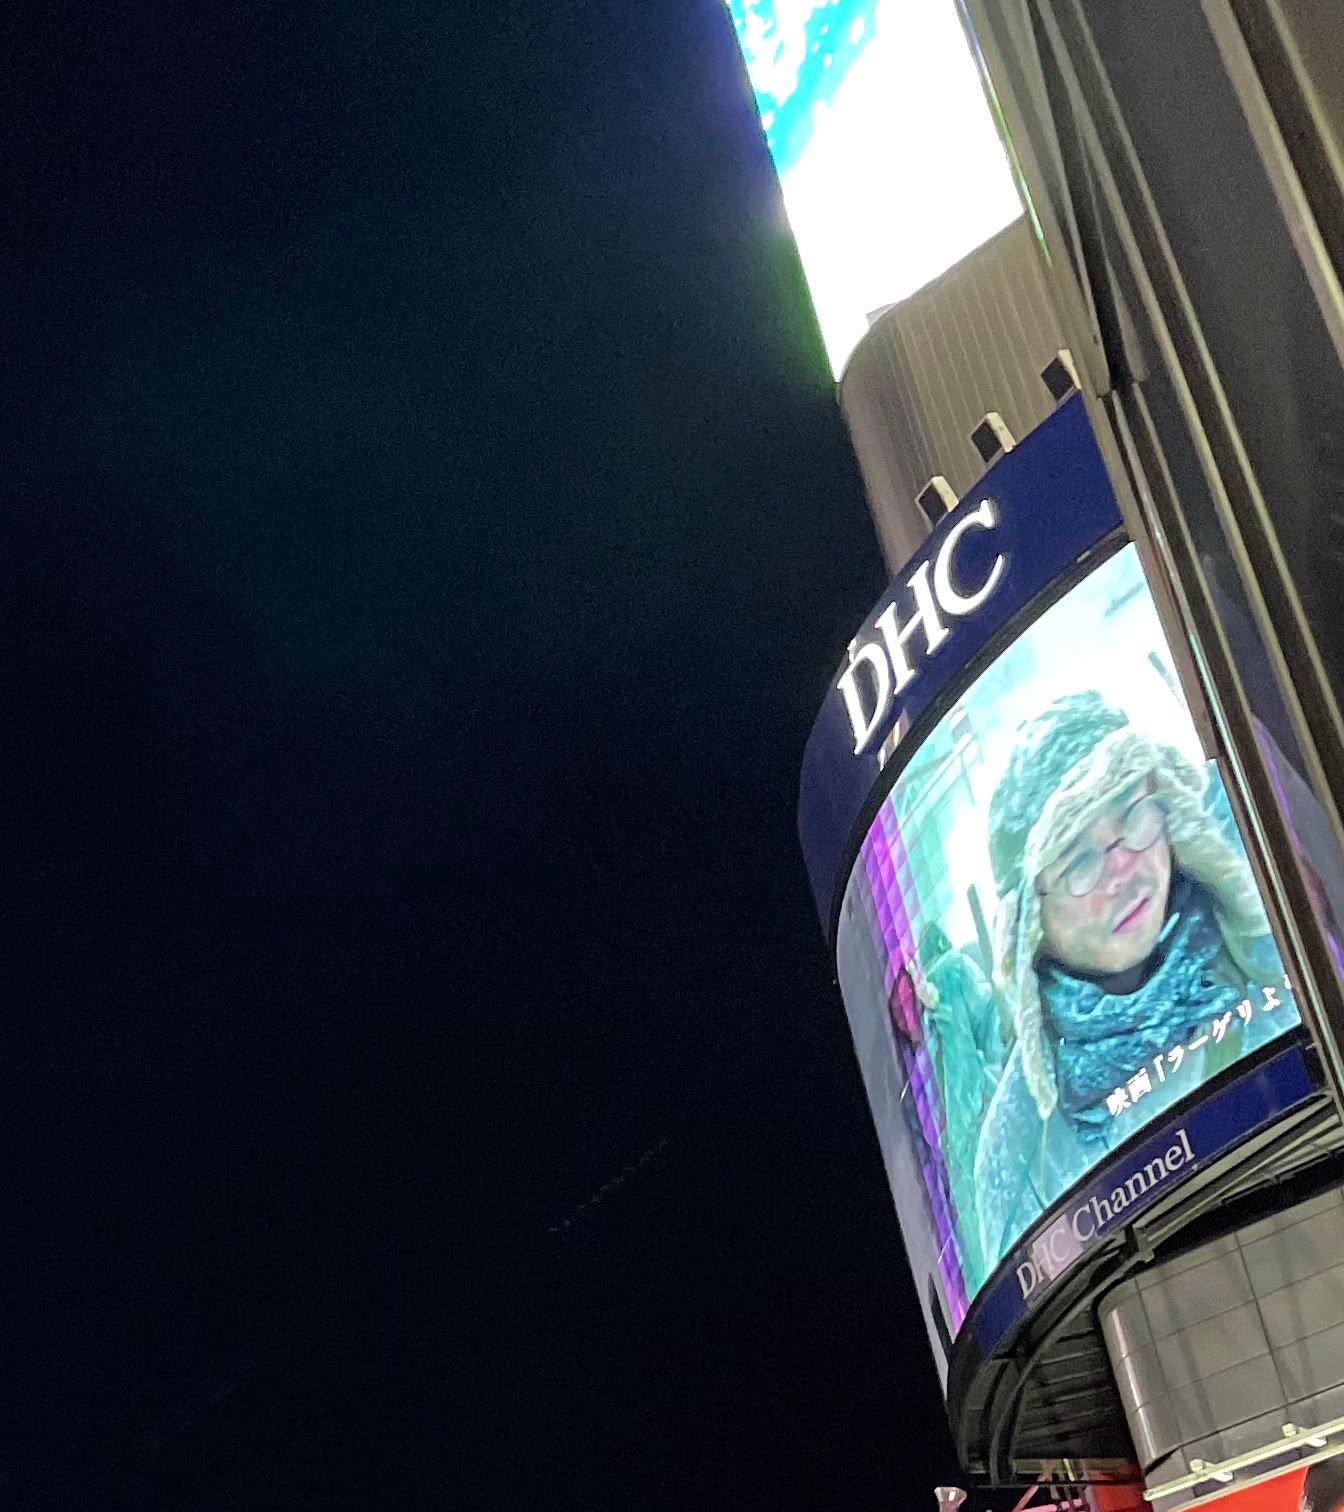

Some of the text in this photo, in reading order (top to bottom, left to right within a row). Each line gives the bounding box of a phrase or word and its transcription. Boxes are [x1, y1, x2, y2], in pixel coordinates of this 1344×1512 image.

[836, 499, 1004, 755] DHC
[1016, 1130, 1196, 1299] DHC Channel
